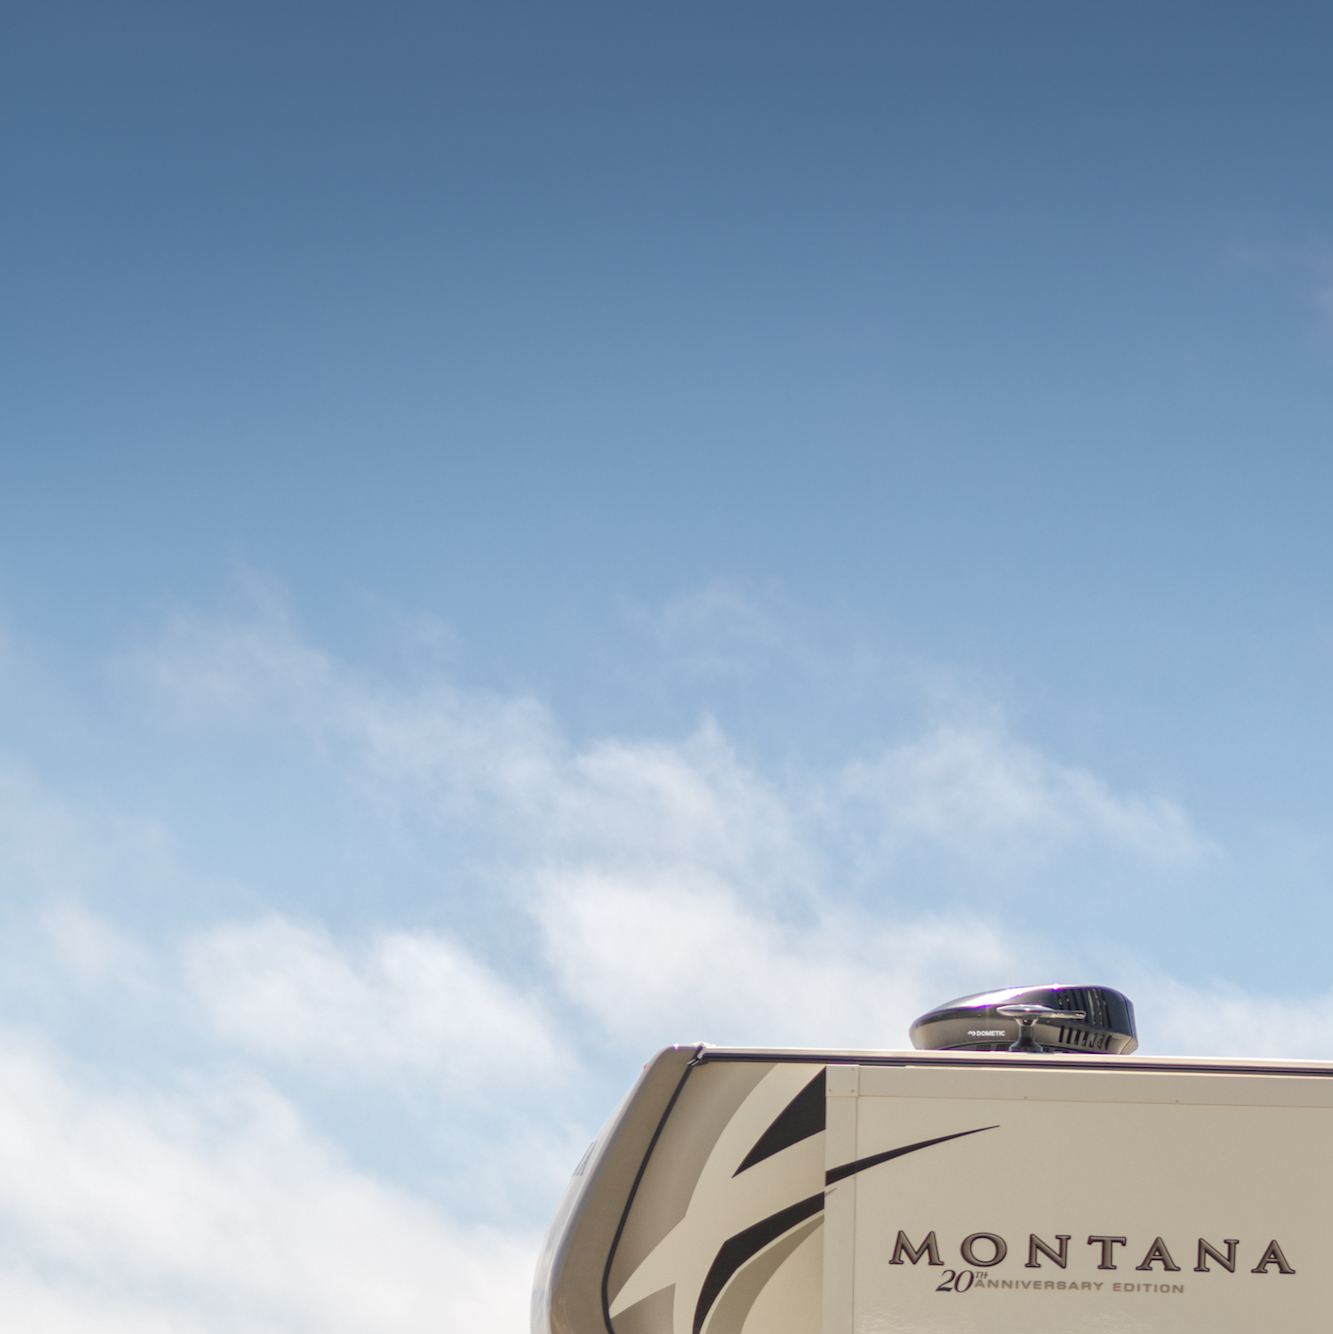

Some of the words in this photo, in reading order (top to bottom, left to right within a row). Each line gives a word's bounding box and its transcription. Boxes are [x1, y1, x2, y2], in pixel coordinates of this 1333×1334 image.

[888, 1230, 1296, 1275] MONTANA
[974, 1279, 1104, 1292] ANNIVERSARY
[1112, 1282, 1185, 1294] EDITION
